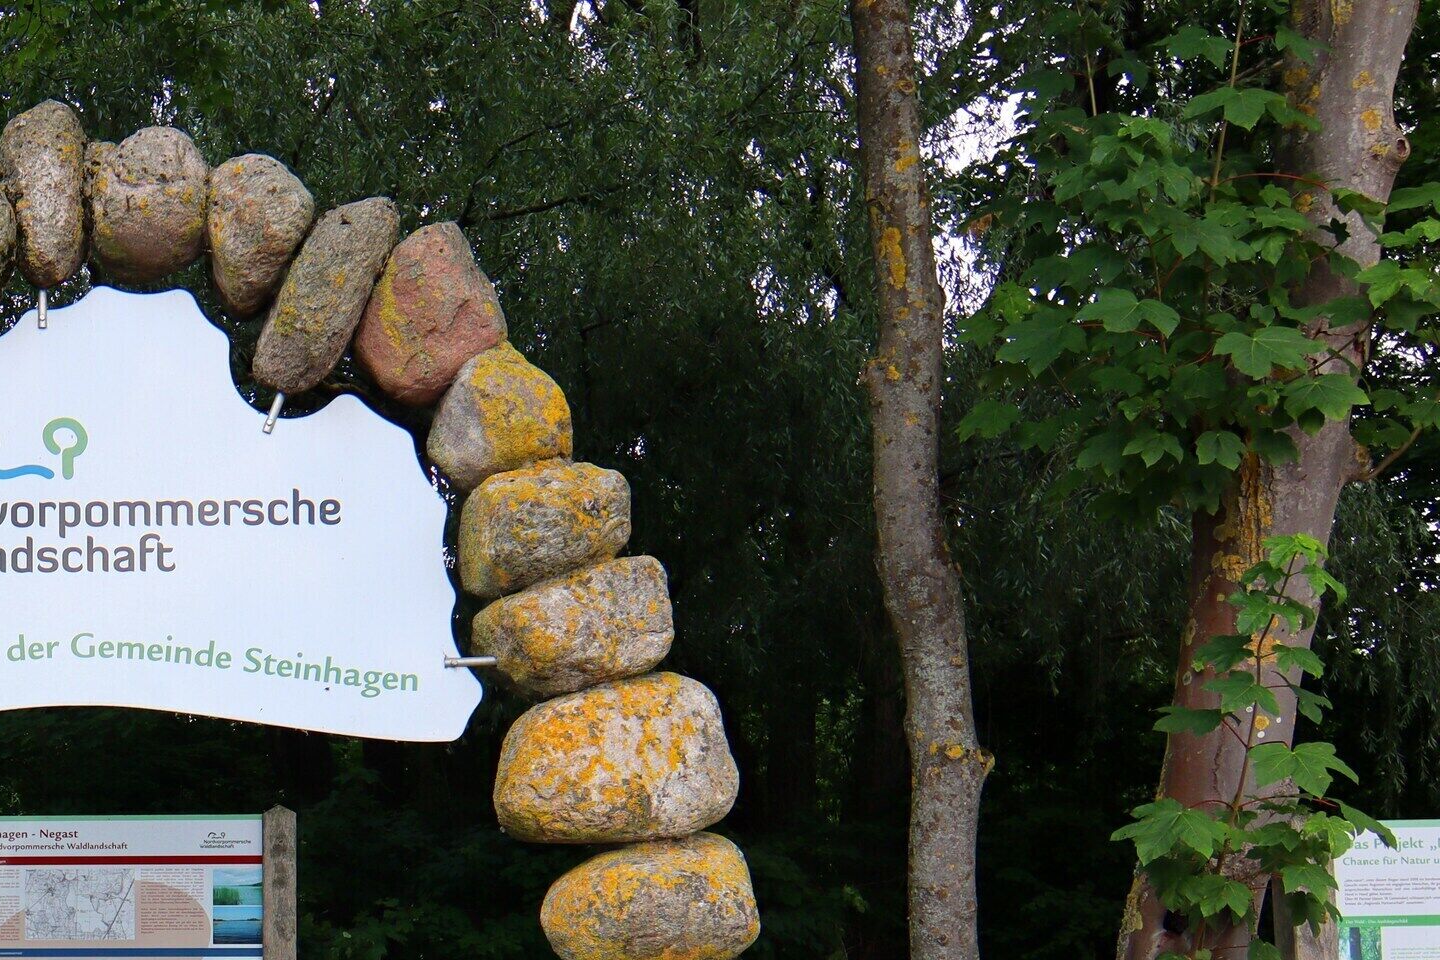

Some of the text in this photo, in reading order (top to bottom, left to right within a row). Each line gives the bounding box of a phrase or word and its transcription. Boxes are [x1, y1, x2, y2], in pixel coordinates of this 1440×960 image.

[6, 633, 59, 662] der
[71, 632, 233, 670] Gemeinde
[243, 647, 419, 699] Steinhagen
[39, 829, 78, 841] Negast
[67, 842, 128, 850] Waldlandschaft
[1343, 858, 1380, 866] Chance
[1383, 857, 1397, 865] für
